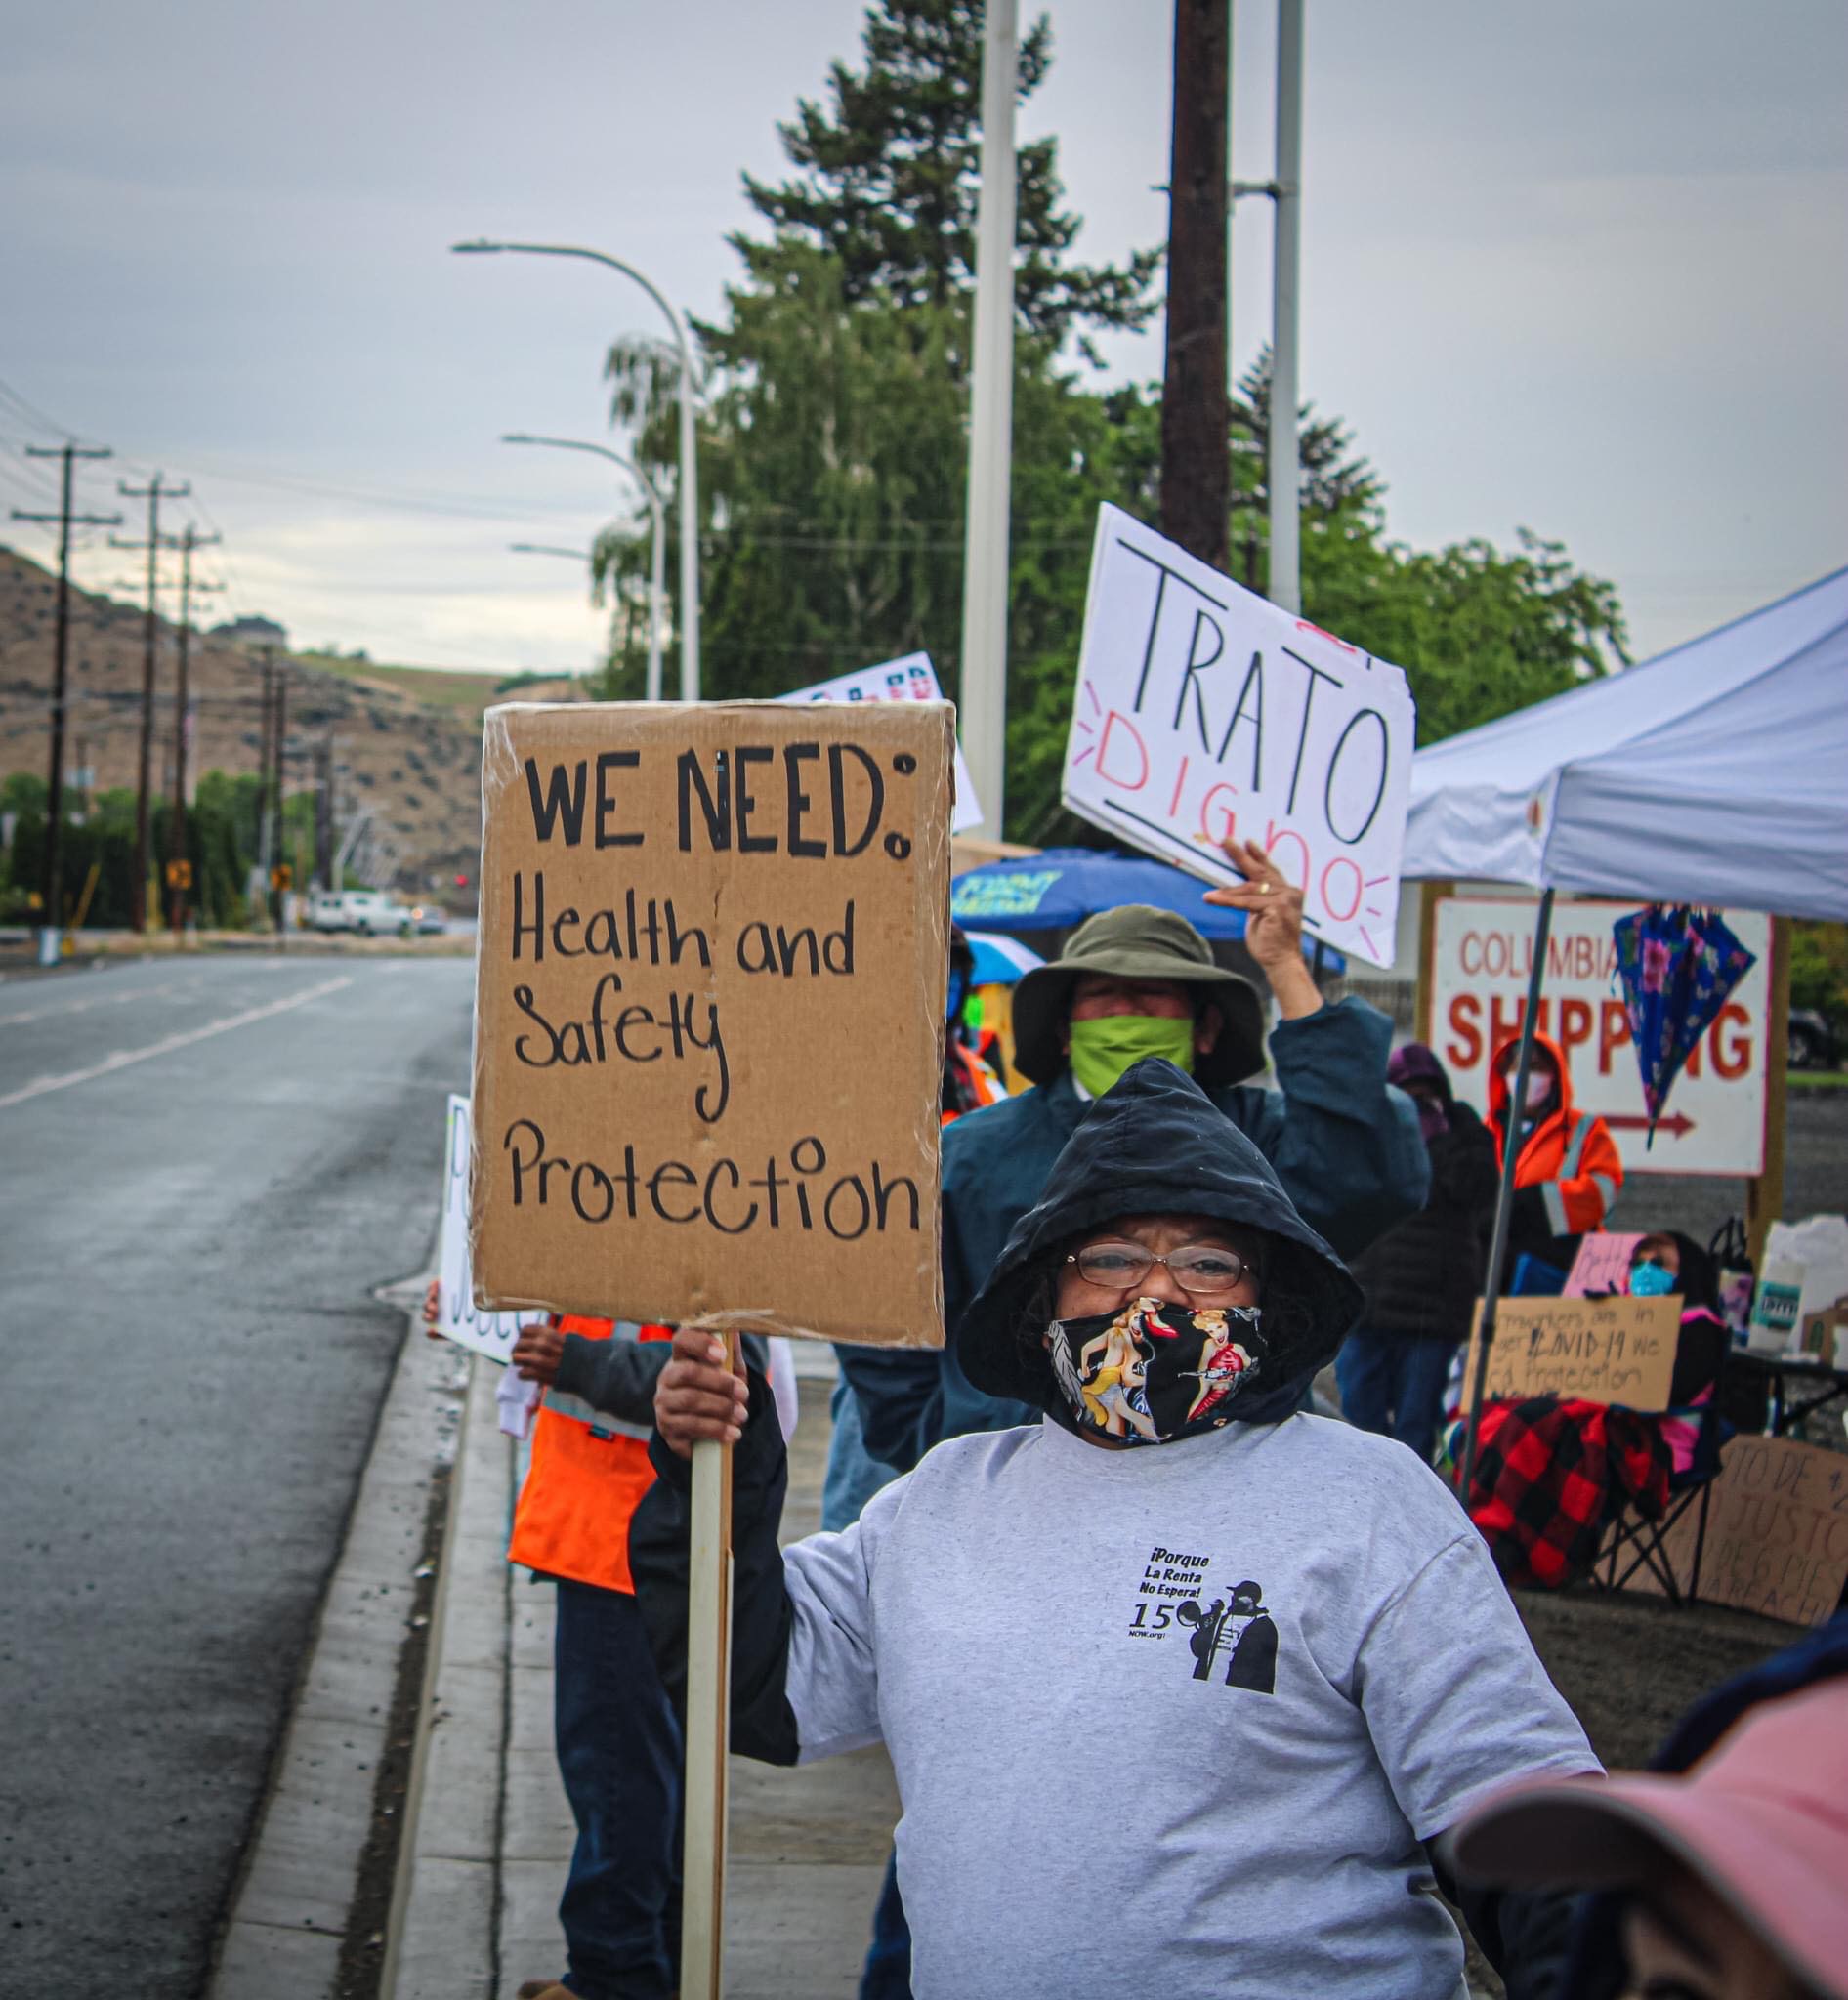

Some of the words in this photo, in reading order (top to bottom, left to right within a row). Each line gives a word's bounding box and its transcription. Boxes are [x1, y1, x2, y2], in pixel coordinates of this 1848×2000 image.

[1116, 538, 1388, 844] TRATO
[525, 750, 645, 850] WE
[677, 743, 918, 859] NEED:
[512, 871, 711, 968] Health
[736, 898, 856, 977] and
[513, 973, 731, 1124] Safety
[1447, 994, 1751, 1080] SHPPG
[503, 1118, 920, 1240] Protection
[1129, 1603, 1174, 1629] 15
[1139, 1581, 1156, 1594] No
[1157, 1583, 1201, 1599] Espera!
[1145, 1565, 1160, 1579] La
[1163, 1568, 1202, 1583] Renta
